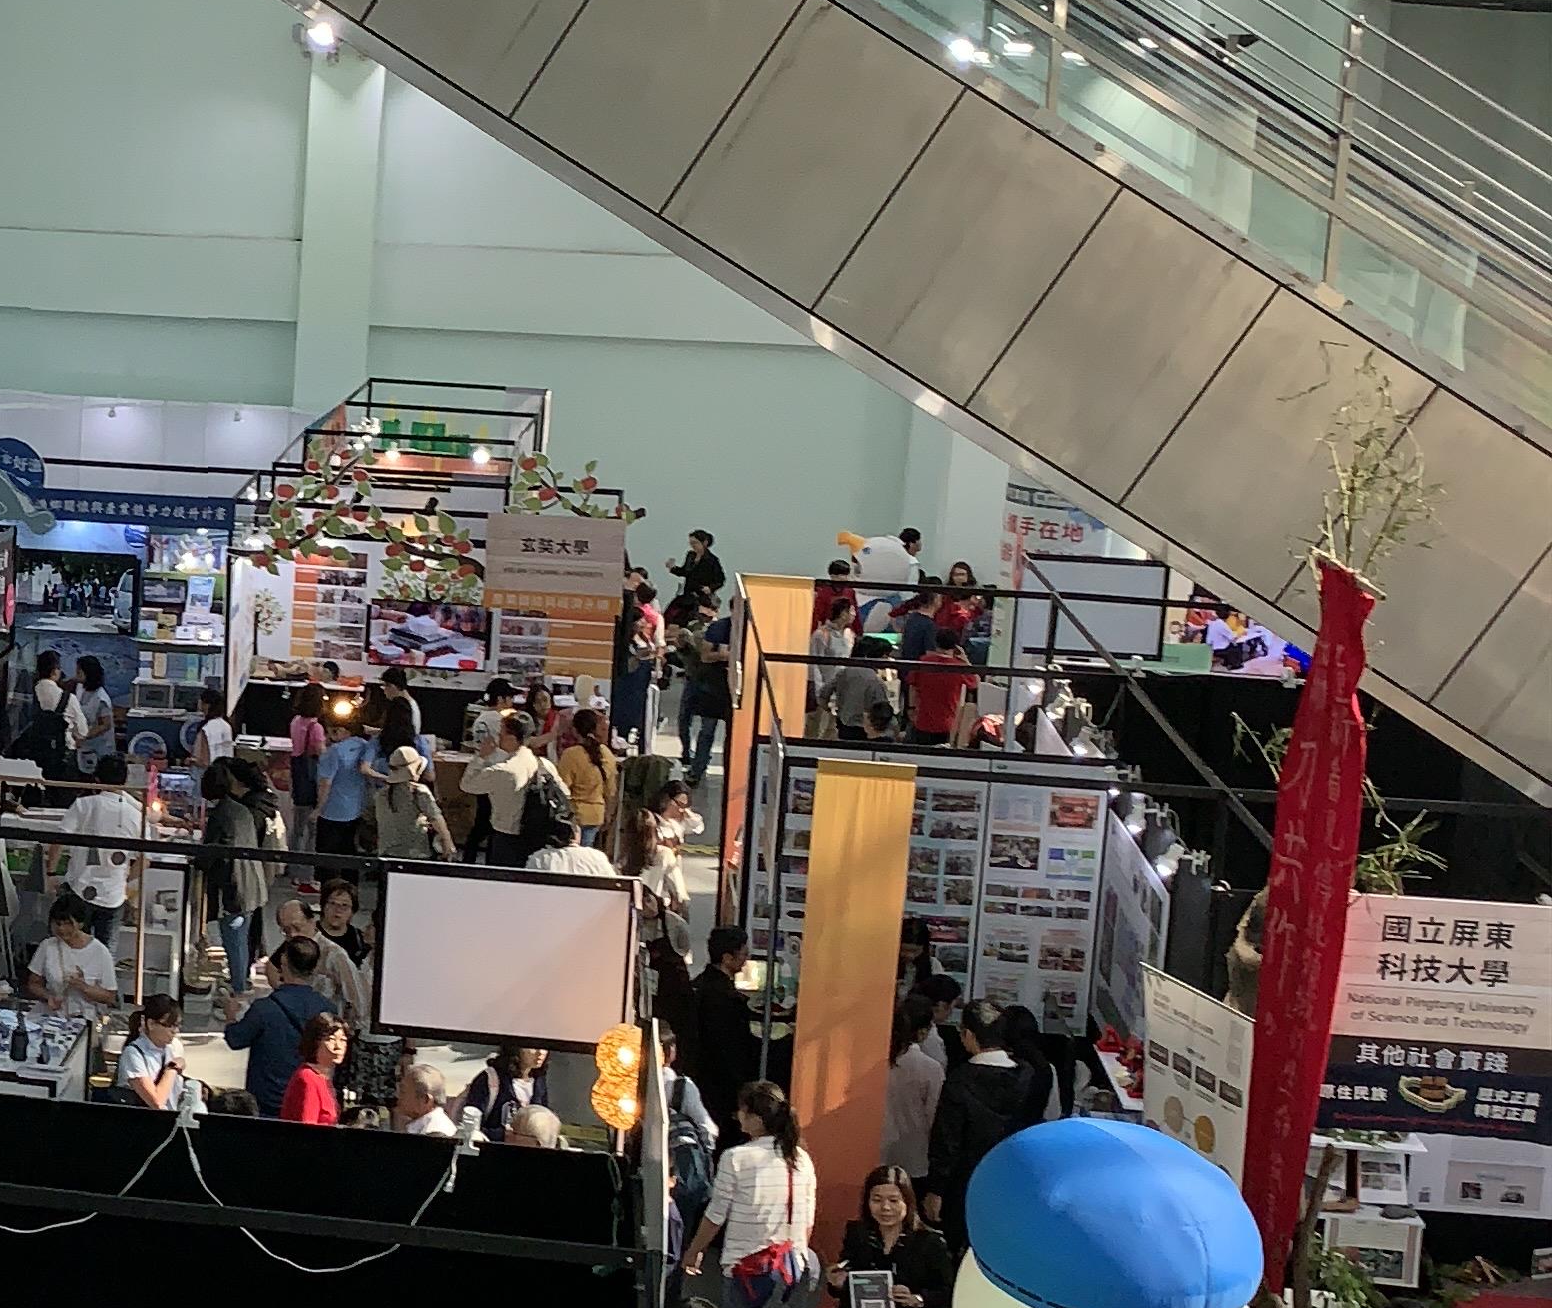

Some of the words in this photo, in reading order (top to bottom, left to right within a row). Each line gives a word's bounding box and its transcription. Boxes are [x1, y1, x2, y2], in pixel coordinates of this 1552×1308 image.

[1381, 914, 1515, 950] 國立屏東
[1376, 952, 1509, 988] 科技大學
[1347, 992, 1401, 1007] National
[1405, 996, 1465, 1014] Pingtung
[1469, 1001, 1537, 1018] University
[1350, 1011, 1364, 1021] of
[1367, 1011, 1419, 1025] Science
[1423, 1015, 1449, 1027] and
[1453, 1017, 1530, 1035] Technology
[1355, 1042, 1509, 1074] 其他社會實踐
